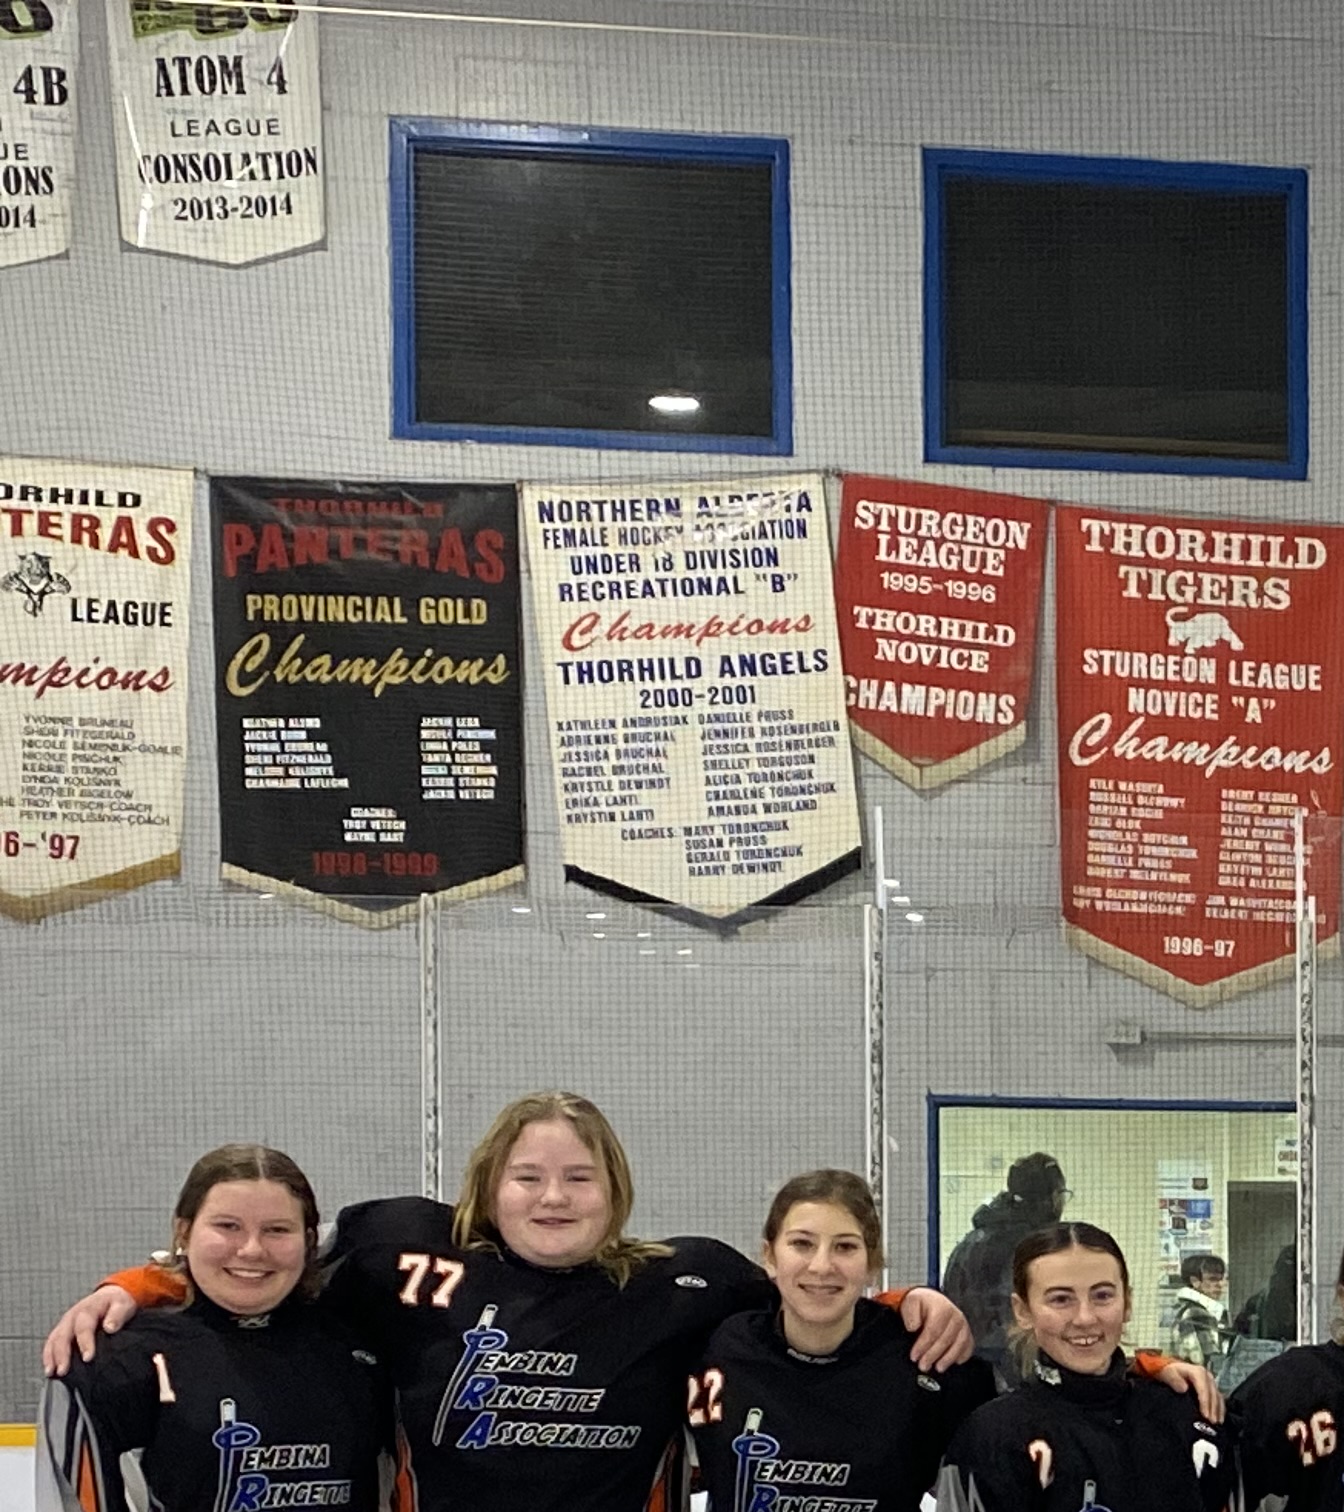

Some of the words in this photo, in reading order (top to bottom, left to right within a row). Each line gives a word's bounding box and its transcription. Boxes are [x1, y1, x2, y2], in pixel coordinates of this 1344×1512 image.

[13, 64, 69, 106] 4B
[155, 55, 245, 97] ATOM
[266, 55, 288, 95] 4
[170, 118, 280, 138] LEAGUE
[138, 146, 318, 184] CONSOLATION
[173, 193, 292, 221] 2013-2014
[538, 497, 682, 523] NORTHERN
[854, 500, 1031, 550] STURGEON
[222, 522, 505, 584] PANTERAS
[543, 528, 609, 549] FEMALE
[875, 534, 1006, 577] LEAGUE
[1080, 518, 1327, 571] THORHILD
[570, 553, 641, 575] UNDER
[686, 547, 779, 571] DIVISION
[559, 575, 745, 601] RECREATIONAL
[879, 571, 996, 604] 1995-1996
[1118, 564, 1291, 611] TIGERS
[71, 599, 173, 628] LEAGUE
[246, 594, 408, 623] PROVINCIAL
[419, 597, 488, 624] GOLD
[853, 606, 1016, 647] THORHILD
[562, 610, 815, 652] Champions
[226, 632, 511, 698] Champions
[557, 656, 701, 685] THORHILD
[719, 649, 829, 678] ANGELS
[874, 638, 989, 673] NOVICE
[1082, 648, 1217, 685] STURGEON
[1228, 660, 1322, 692] LEAGUE
[640, 685, 755, 708] 2000-2001
[1127, 686, 1219, 721] NOVICE
[1068, 712, 1334, 779] Champions
[398, 1254, 464, 1308] 77
[454, 1375, 605, 1412] RINGETTE
[457, 1412, 640, 1449] ASSOCIATION
